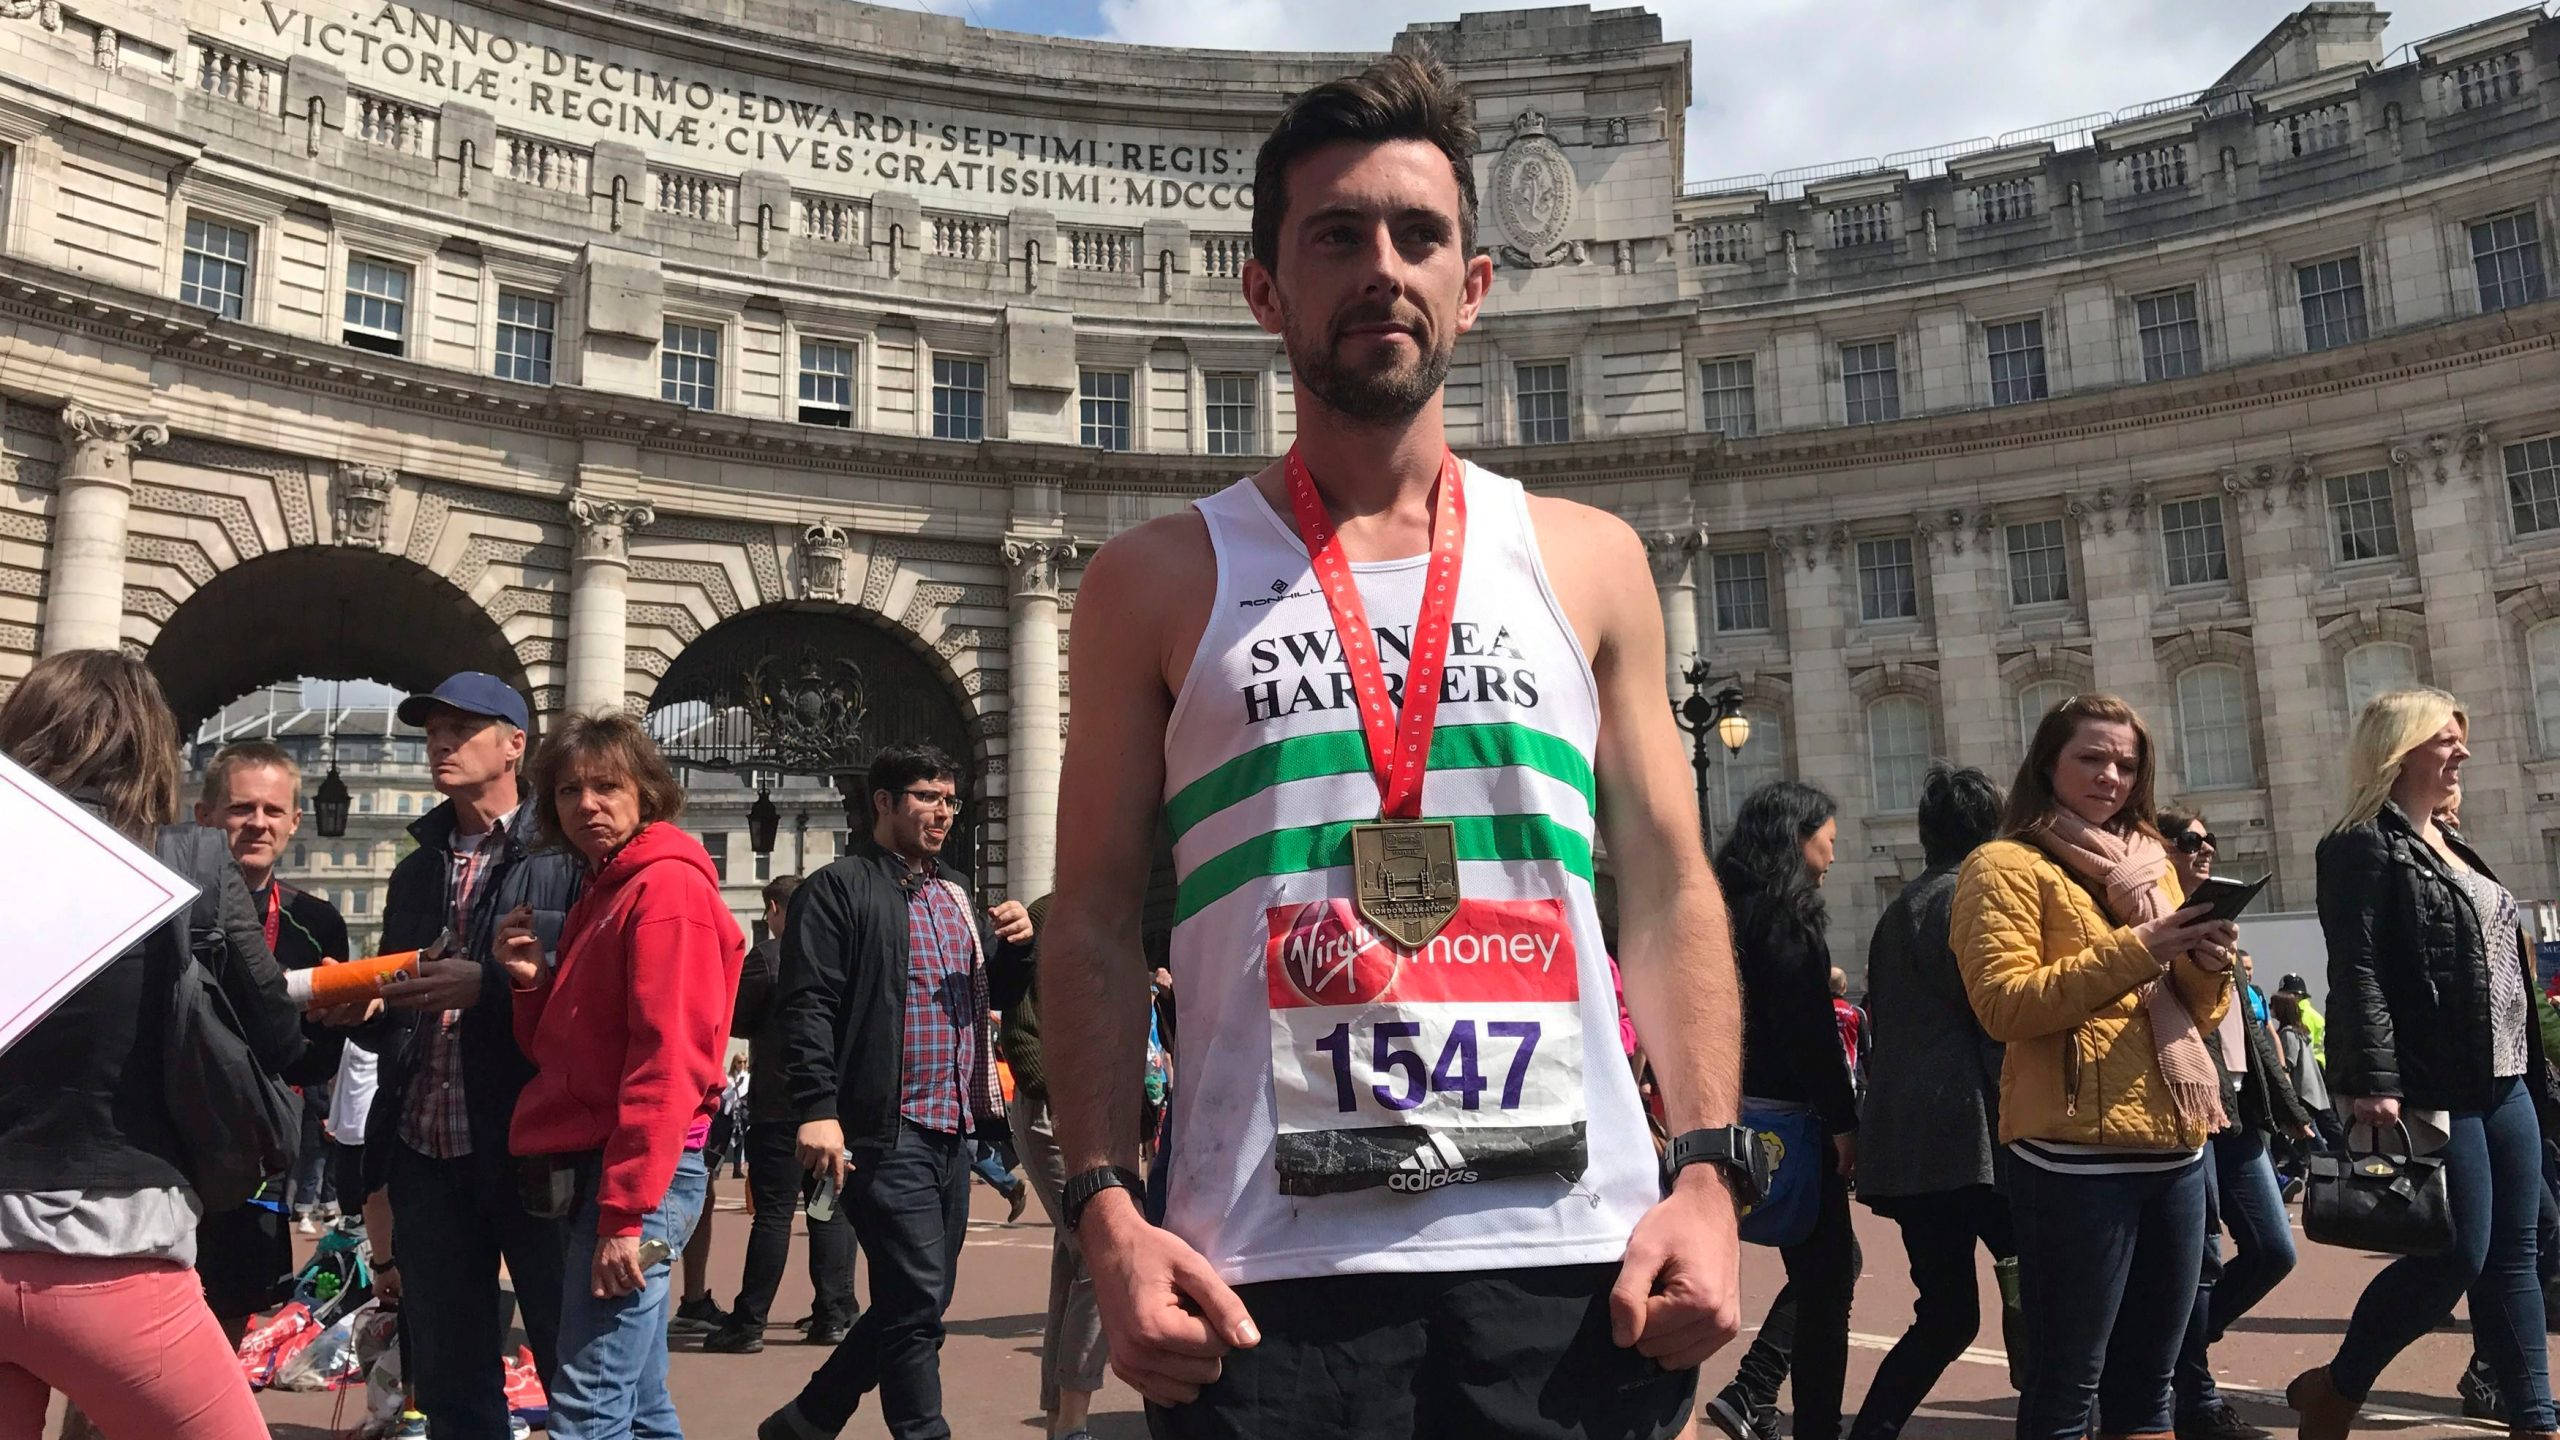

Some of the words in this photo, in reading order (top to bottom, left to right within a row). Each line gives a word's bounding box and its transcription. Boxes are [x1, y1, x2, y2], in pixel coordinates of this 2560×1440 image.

[1250, 621, 1526, 676] SWNEA
[1312, 521, 1345, 593] LONDON
[1344, 609, 1385, 728] MARATHON
[1239, 665, 1540, 726] HARRERS
[1400, 713, 1423, 799] VIRGIN
[1418, 622, 1440, 694] MONEY
[1290, 901, 1390, 995] Virgin
[1411, 931, 1561, 973] money
[1315, 1019, 1542, 1114] 1547
[1387, 1167, 1480, 1192] adidas
